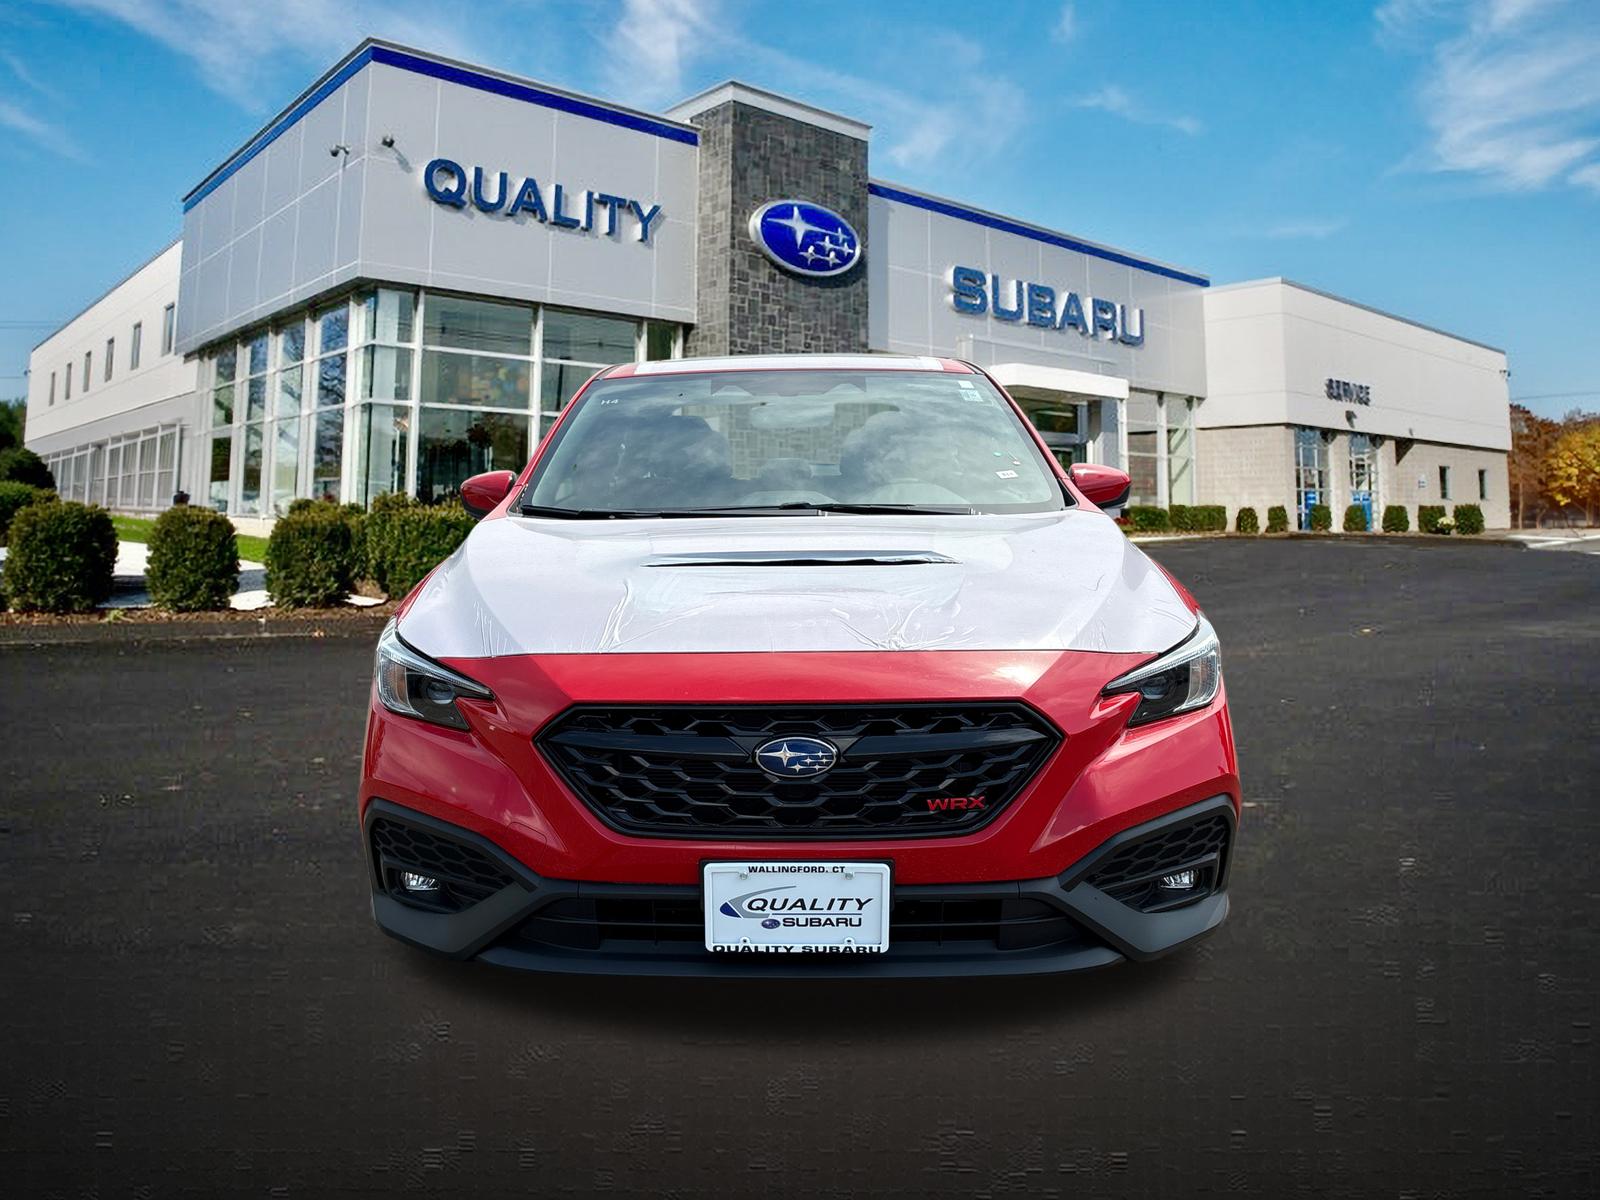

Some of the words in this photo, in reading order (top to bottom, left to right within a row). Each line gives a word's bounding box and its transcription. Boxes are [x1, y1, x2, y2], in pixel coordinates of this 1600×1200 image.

[424, 158, 661, 243] QUALITY
[951, 265, 1145, 346] SUBARU
[1325, 378, 1371, 406] SERVICE
[928, 796, 986, 811] WRX
[747, 898, 873, 911] QUALITY
[782, 917, 862, 927] SUBARU
[713, 945, 793, 953] QUALITY
[802, 945, 881, 953] SUBARU
